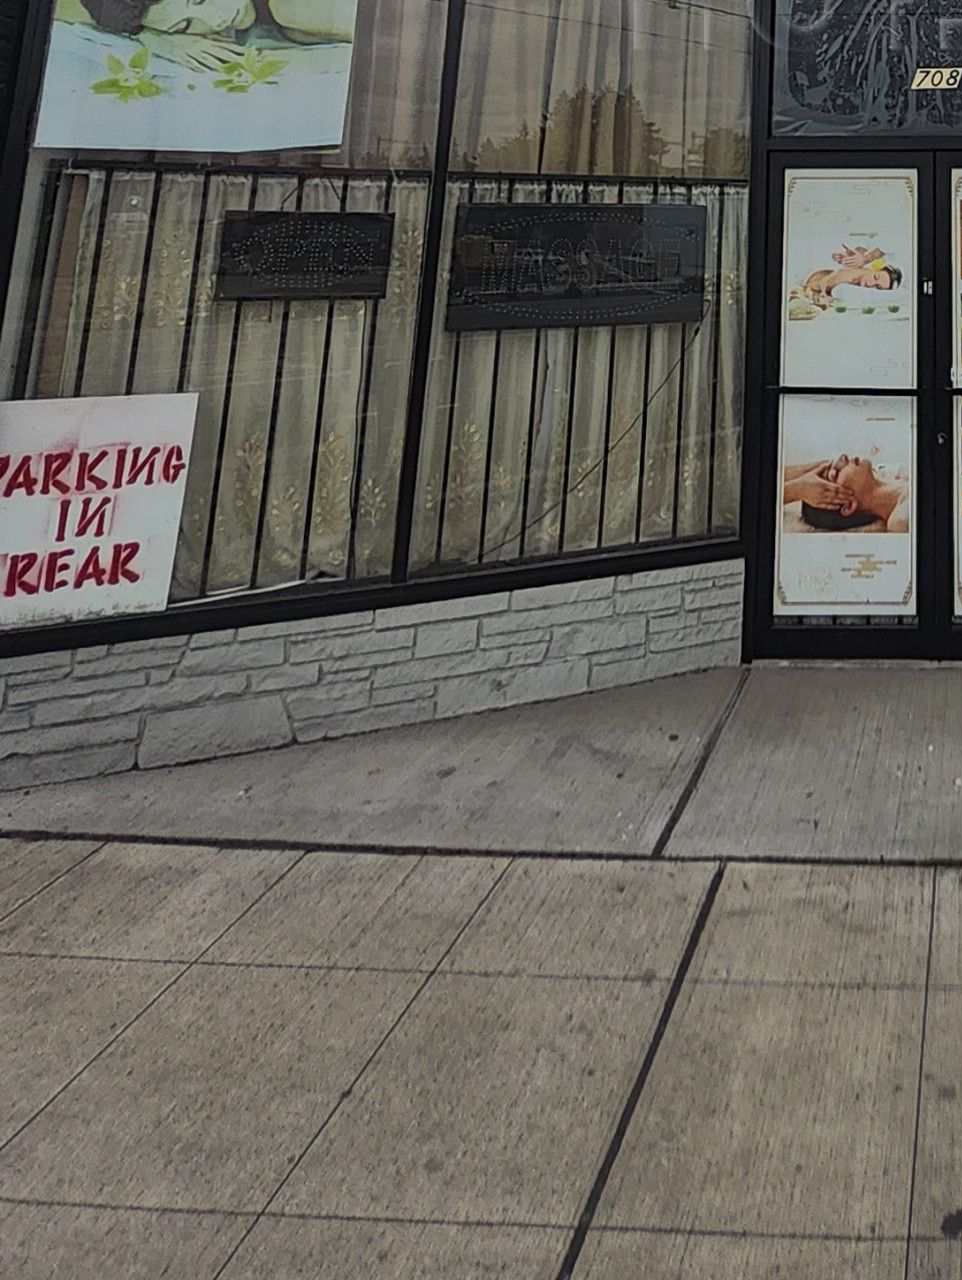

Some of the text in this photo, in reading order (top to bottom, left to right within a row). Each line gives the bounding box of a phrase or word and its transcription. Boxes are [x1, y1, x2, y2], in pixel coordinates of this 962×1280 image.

[916, 70, 960, 87] 708
[55, 496, 111, 542] IN
[4, 541, 141, 597] REAR
